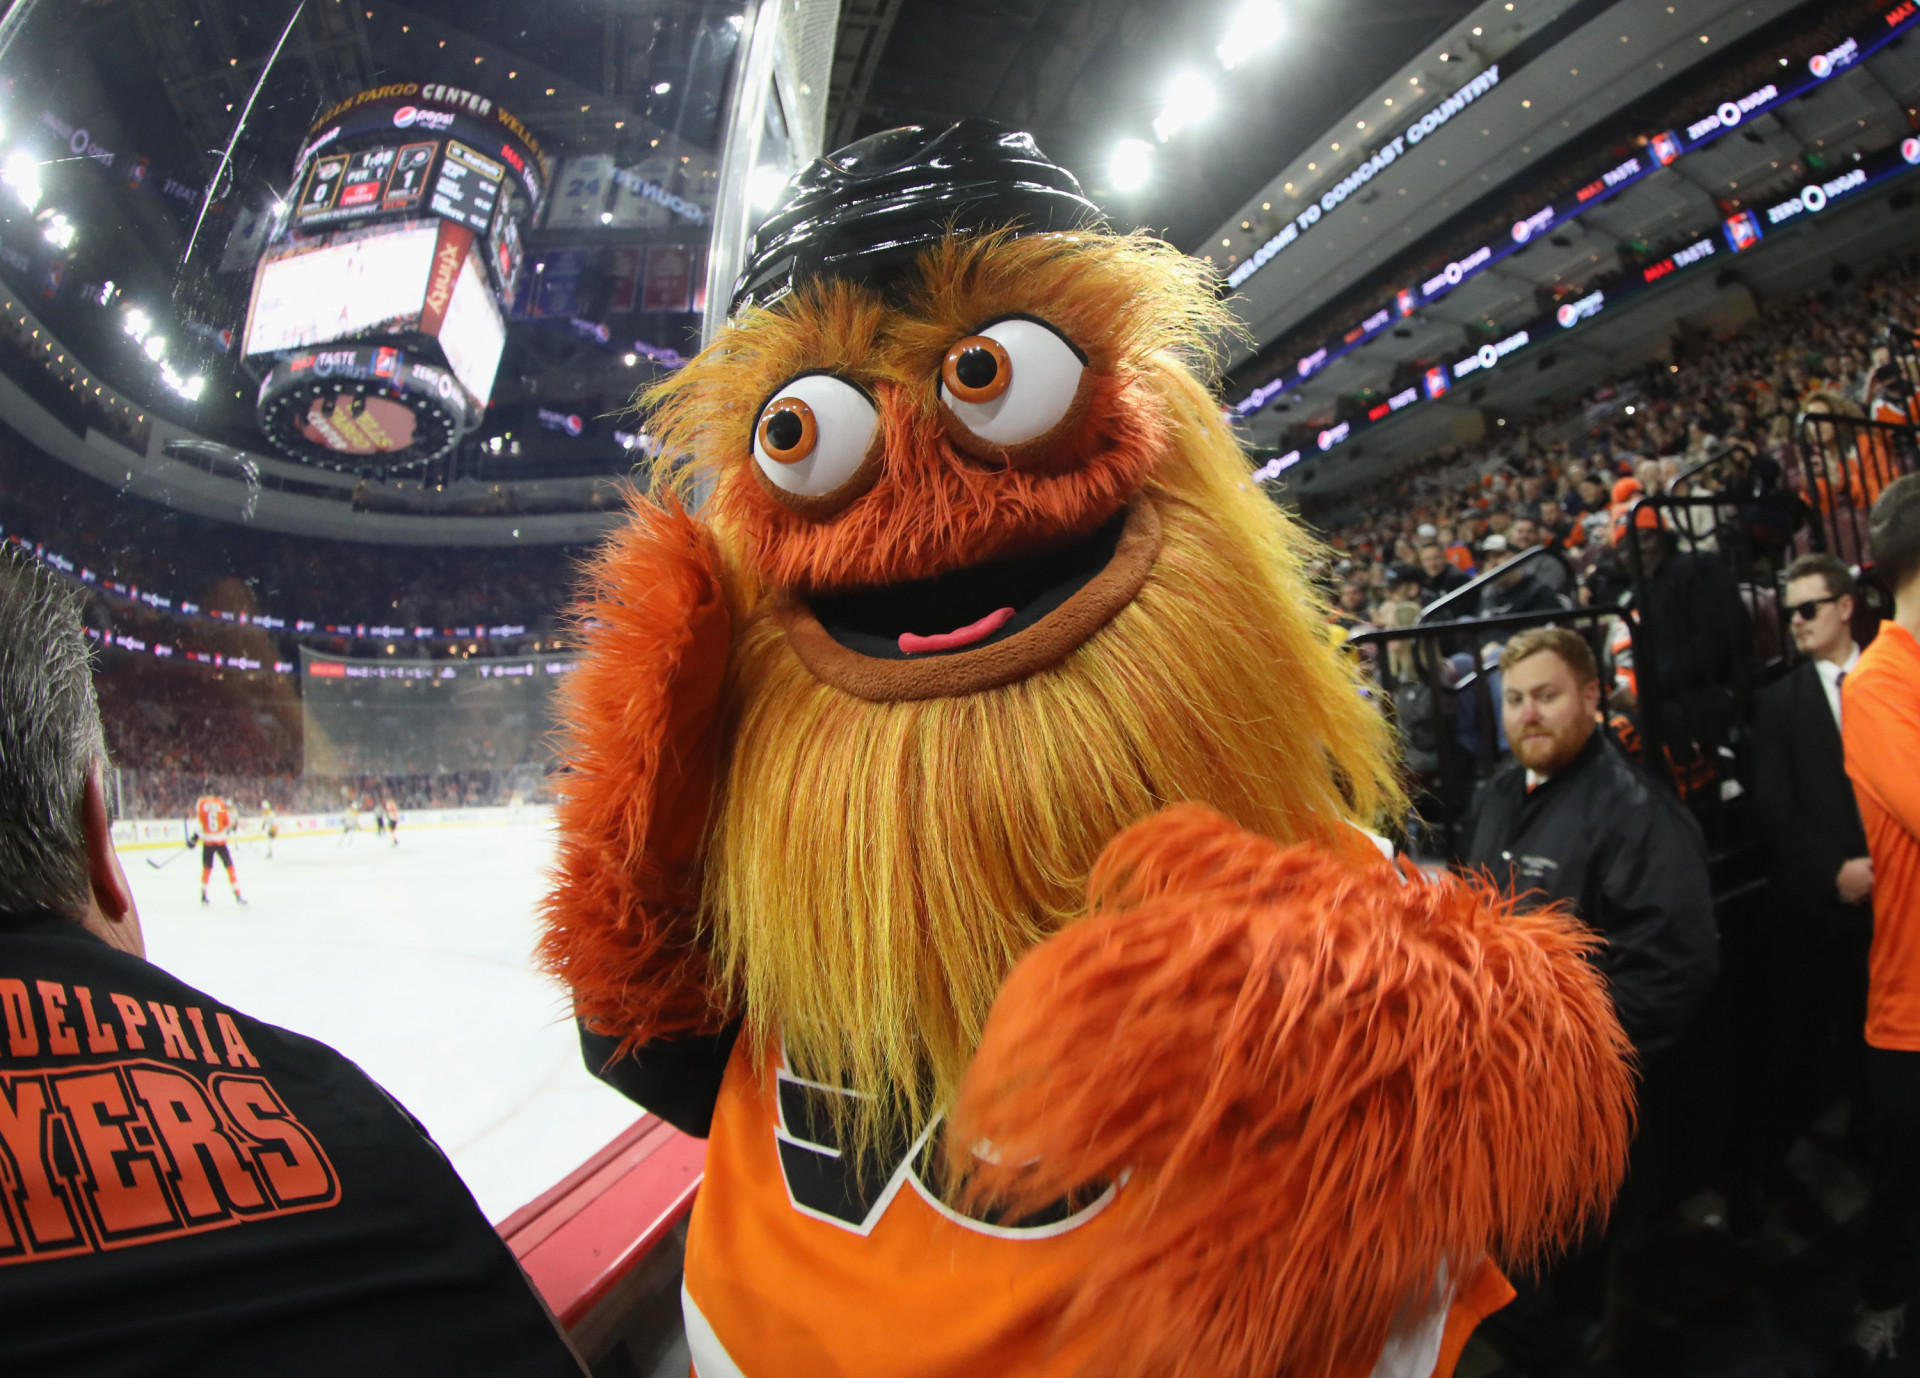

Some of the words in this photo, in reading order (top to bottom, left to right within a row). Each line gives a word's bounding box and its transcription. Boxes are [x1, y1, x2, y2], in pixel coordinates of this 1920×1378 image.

[1885, 1, 1916, 27] MAX
[356, 82, 419, 105] FARGO
[422, 84, 492, 116] CENTER
[1296, 204, 1322, 230] TO
[1321, 135, 1404, 211] COMCAST
[1406, 63, 1500, 144] COUNTRY
[0, 1058, 342, 1266] YERS
